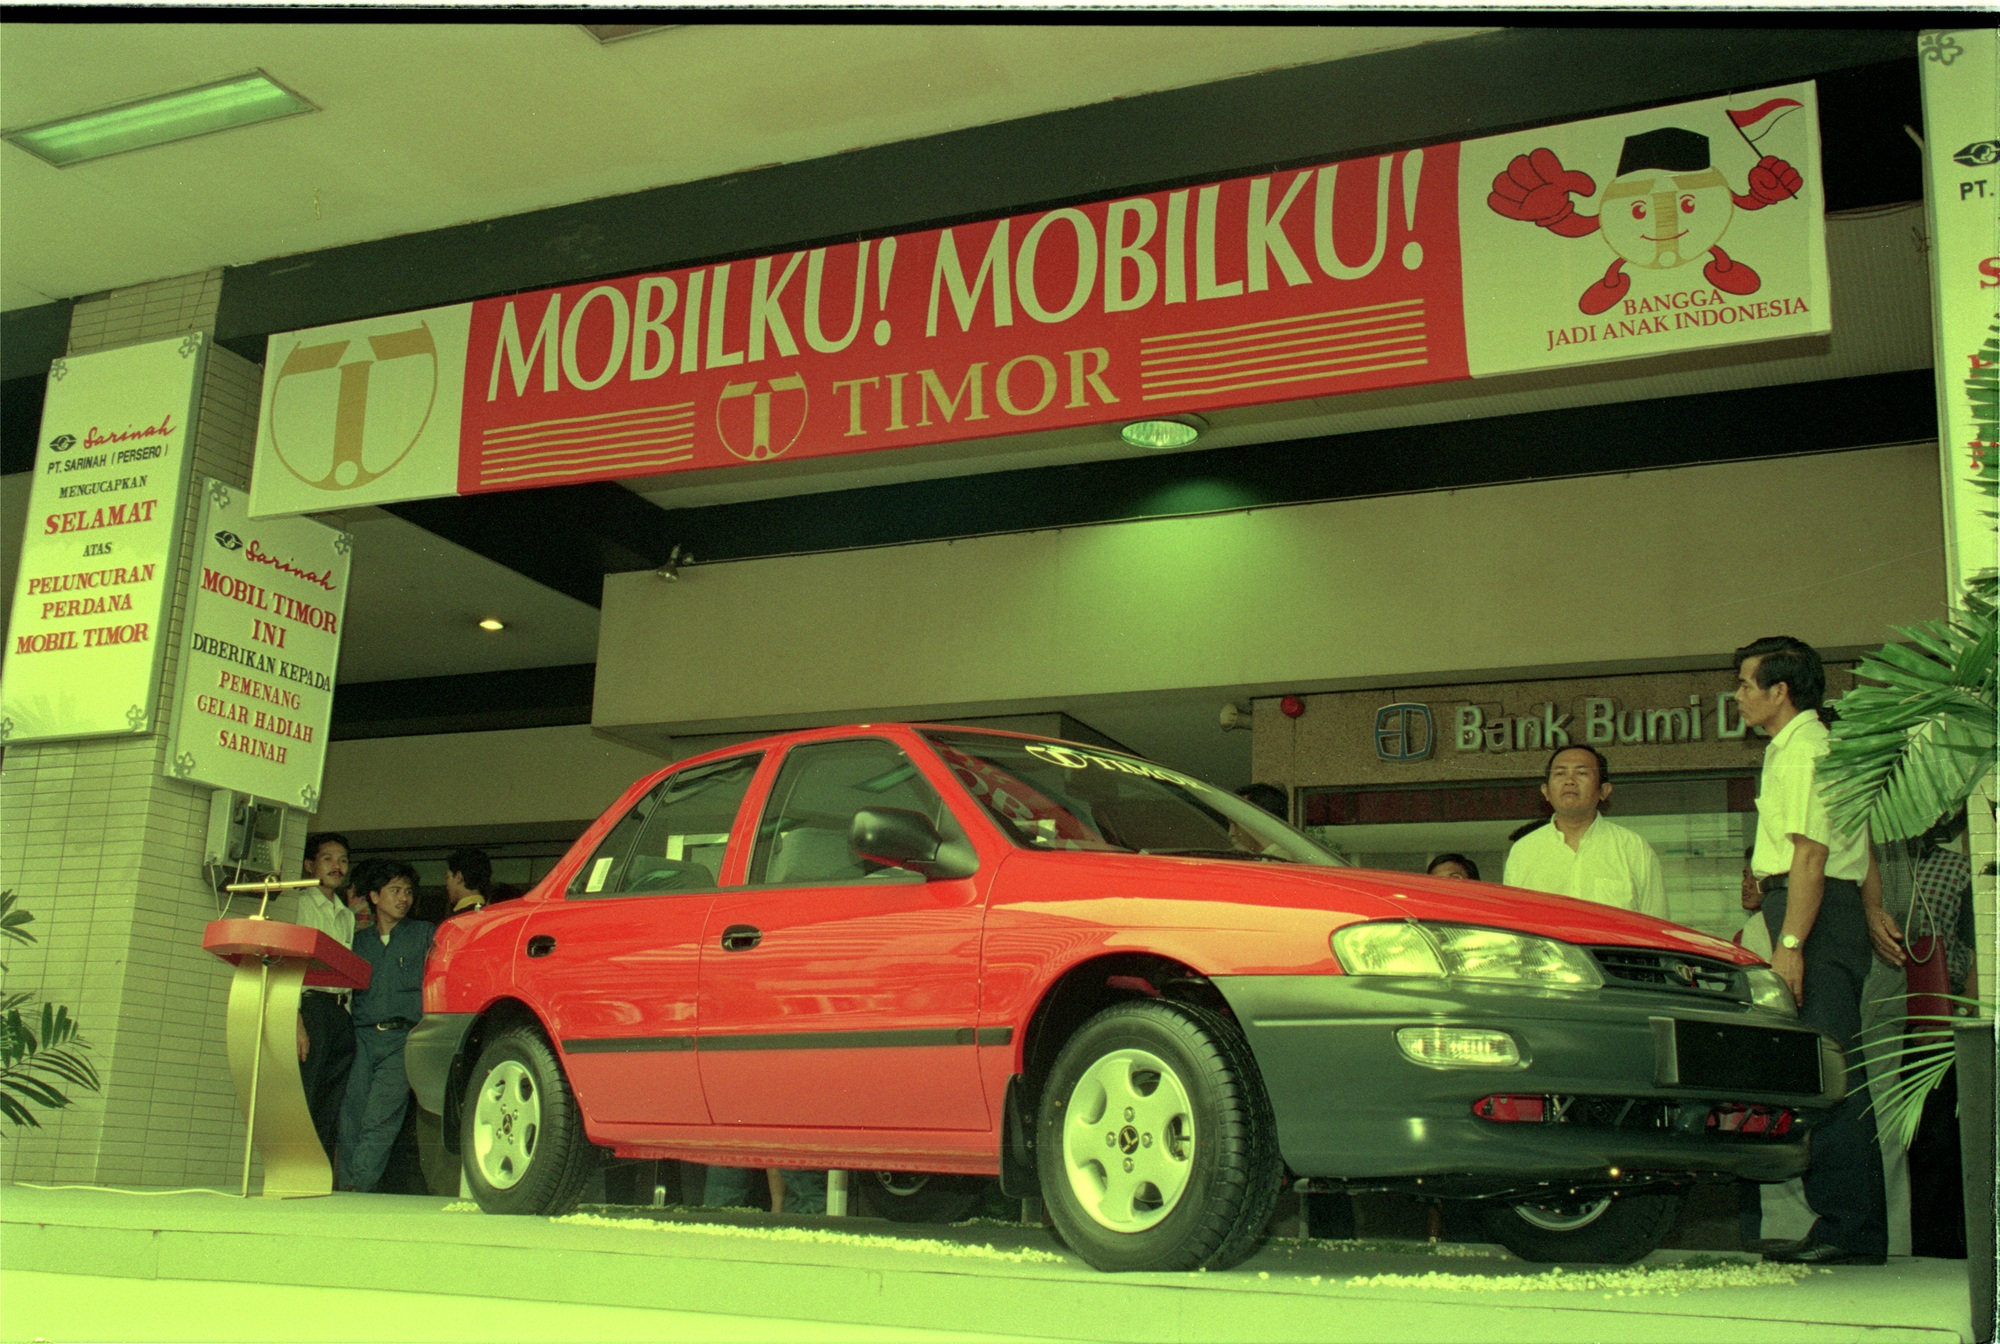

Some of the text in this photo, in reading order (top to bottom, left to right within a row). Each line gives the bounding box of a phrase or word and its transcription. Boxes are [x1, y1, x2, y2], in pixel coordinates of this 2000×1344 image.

[1960, 180, 1994, 201] PT.
[487, 148, 1424, 402] MOBILKU! MOBILKU!
[1623, 288, 1725, 316] BANGGA
[1547, 297, 1810, 351] JADI ANAK INDONESIA
[833, 346, 1120, 437] TIMOR
[84, 414, 177, 449] Sarinah
[47, 461, 62, 474] PT.
[64, 454, 107, 472] SARINAH
[59, 475, 148, 499] MENGUCAPKAN
[45, 499, 158, 535] SELAMAT
[83, 542, 112, 557] ATAS
[246, 540, 336, 591] Sarinah
[27, 564, 155, 595] PELUNCURAN
[41, 593, 132, 620] PERDANA
[201, 567, 337, 635] MOBIL TIMOR
[15, 623, 149, 654] MOBIL TIMOR
[252, 618, 287, 649] INI
[192, 633, 331, 692] DIBERIKAN KEPADA
[218, 671, 300, 710] PEMENANG
[197, 694, 313, 743] GELAR HADIAH
[1455, 702, 1570, 751] Bank
[1585, 694, 1701, 744] Bumi
[219, 729, 287, 764] SARINAH
